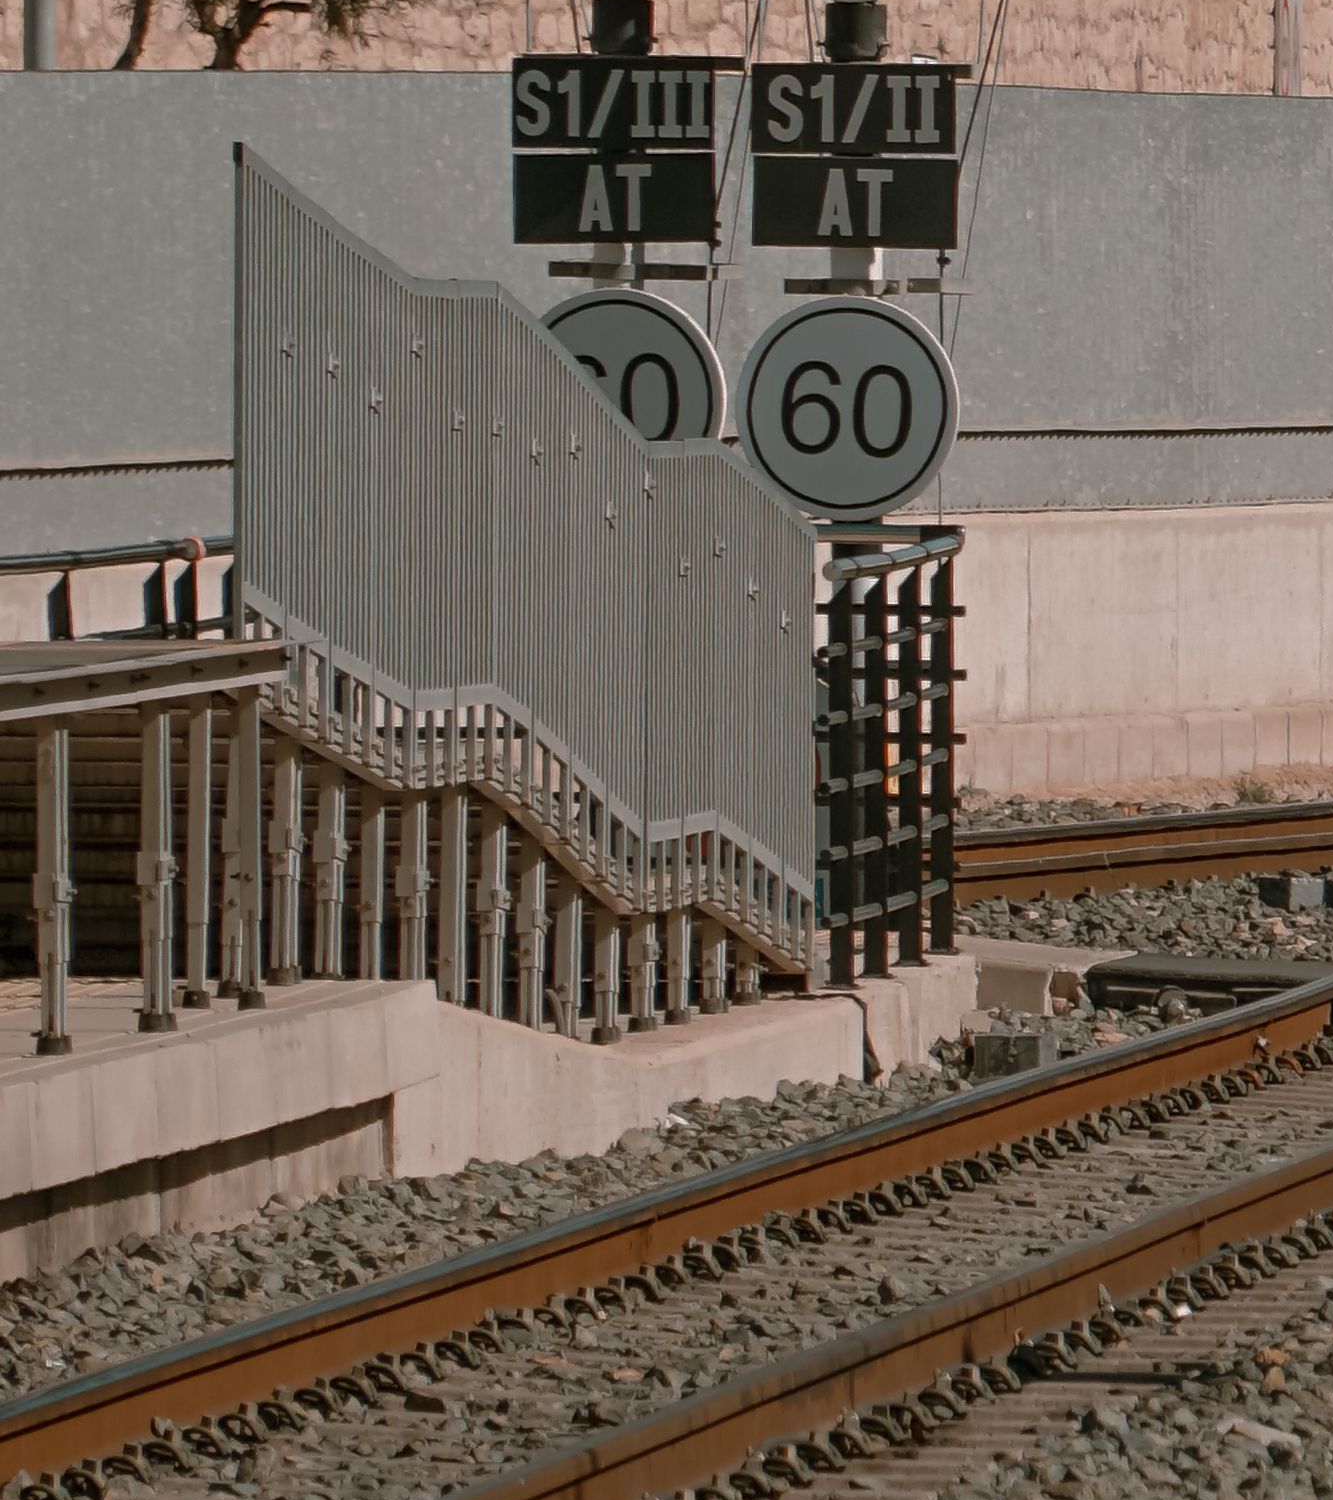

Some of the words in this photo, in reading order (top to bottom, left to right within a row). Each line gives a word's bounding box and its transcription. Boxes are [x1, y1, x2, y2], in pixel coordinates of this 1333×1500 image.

[516, 69, 710, 139] S1/III
[768, 74, 941, 143] S1/II
[579, 164, 652, 232] AT
[817, 168, 893, 237] AT
[575, 353, 680, 441] 0
[780, 361, 912, 458] 60
